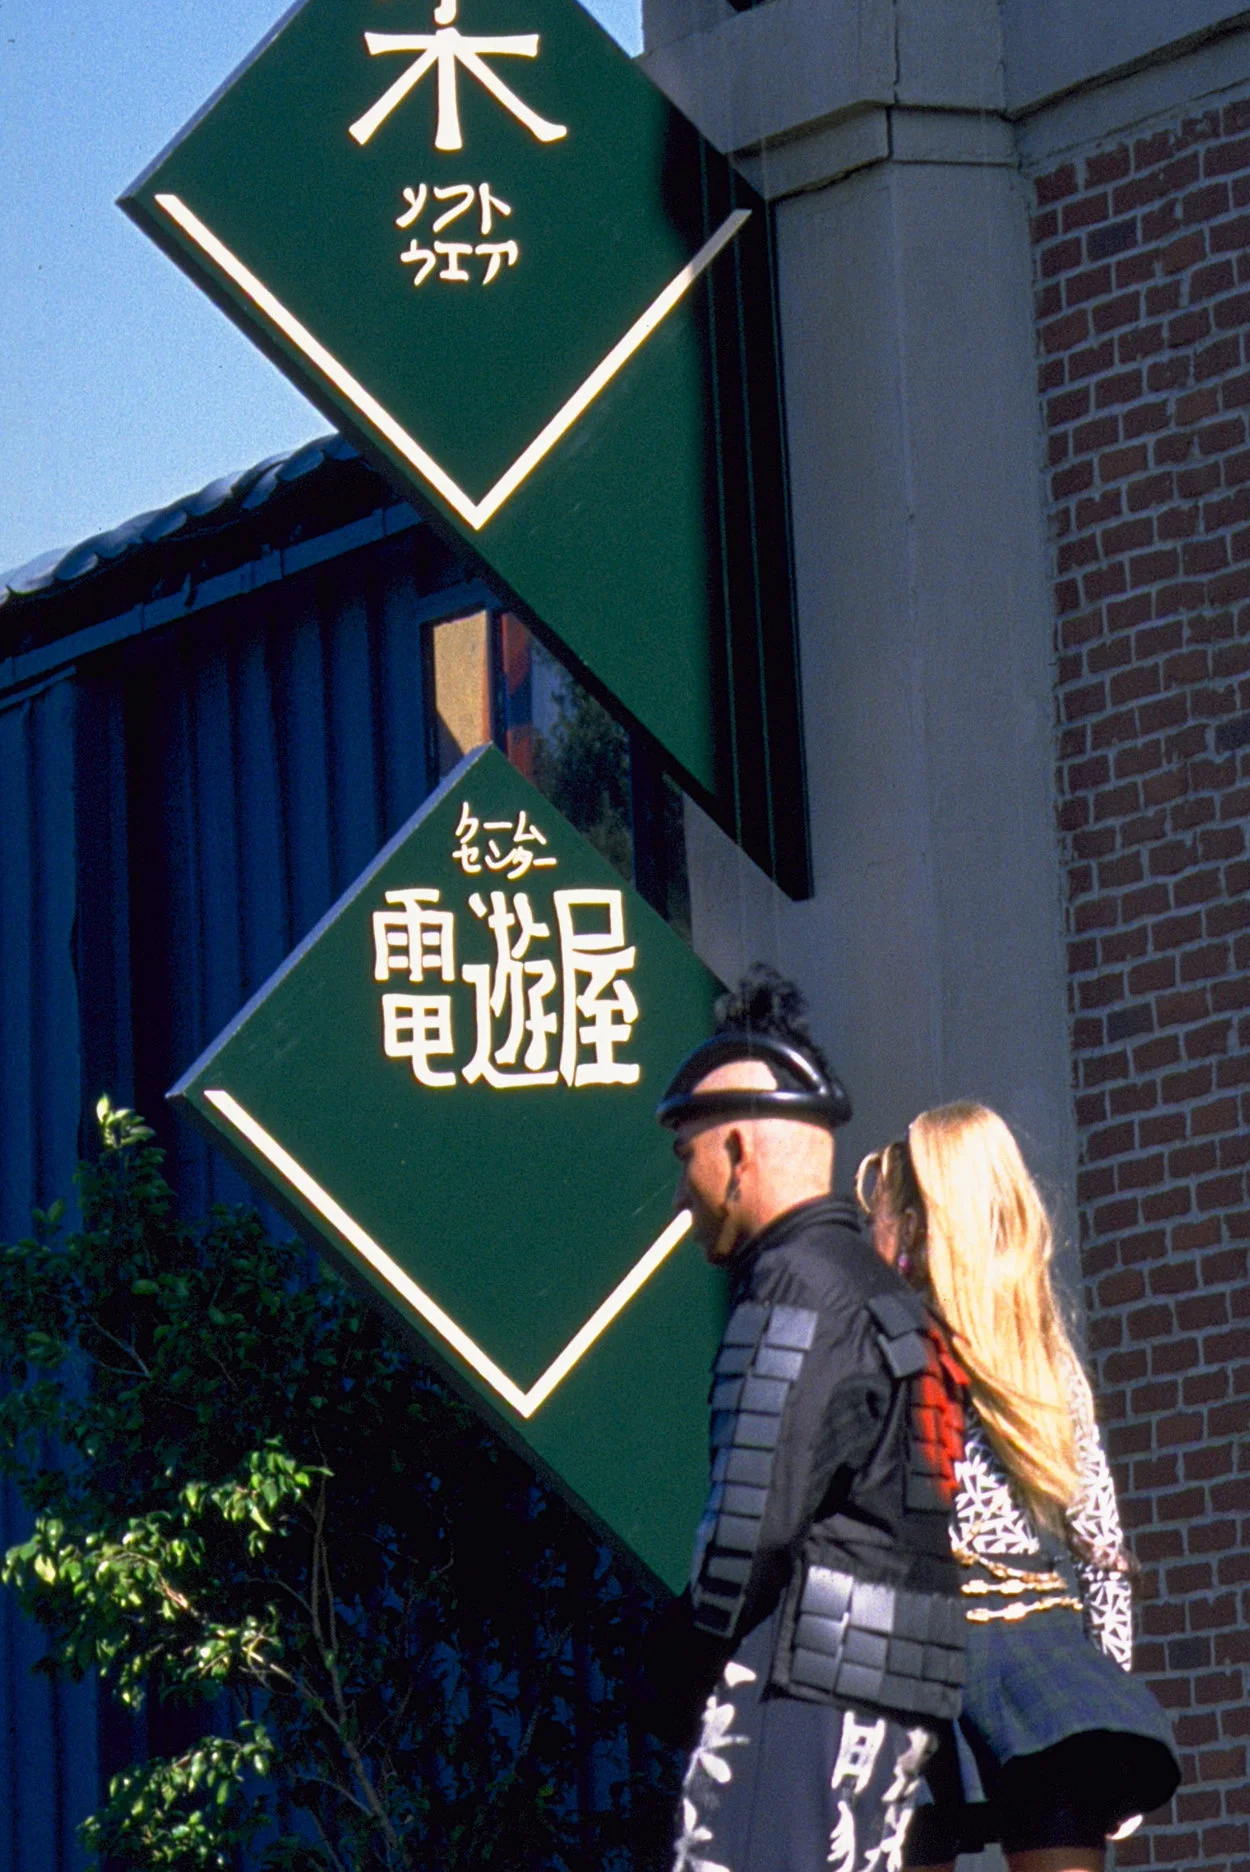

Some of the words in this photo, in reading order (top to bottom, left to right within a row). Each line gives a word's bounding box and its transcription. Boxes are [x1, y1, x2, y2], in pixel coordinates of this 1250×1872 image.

[395, 182, 512, 235] ソフト
[452, 839, 557, 880] センター
